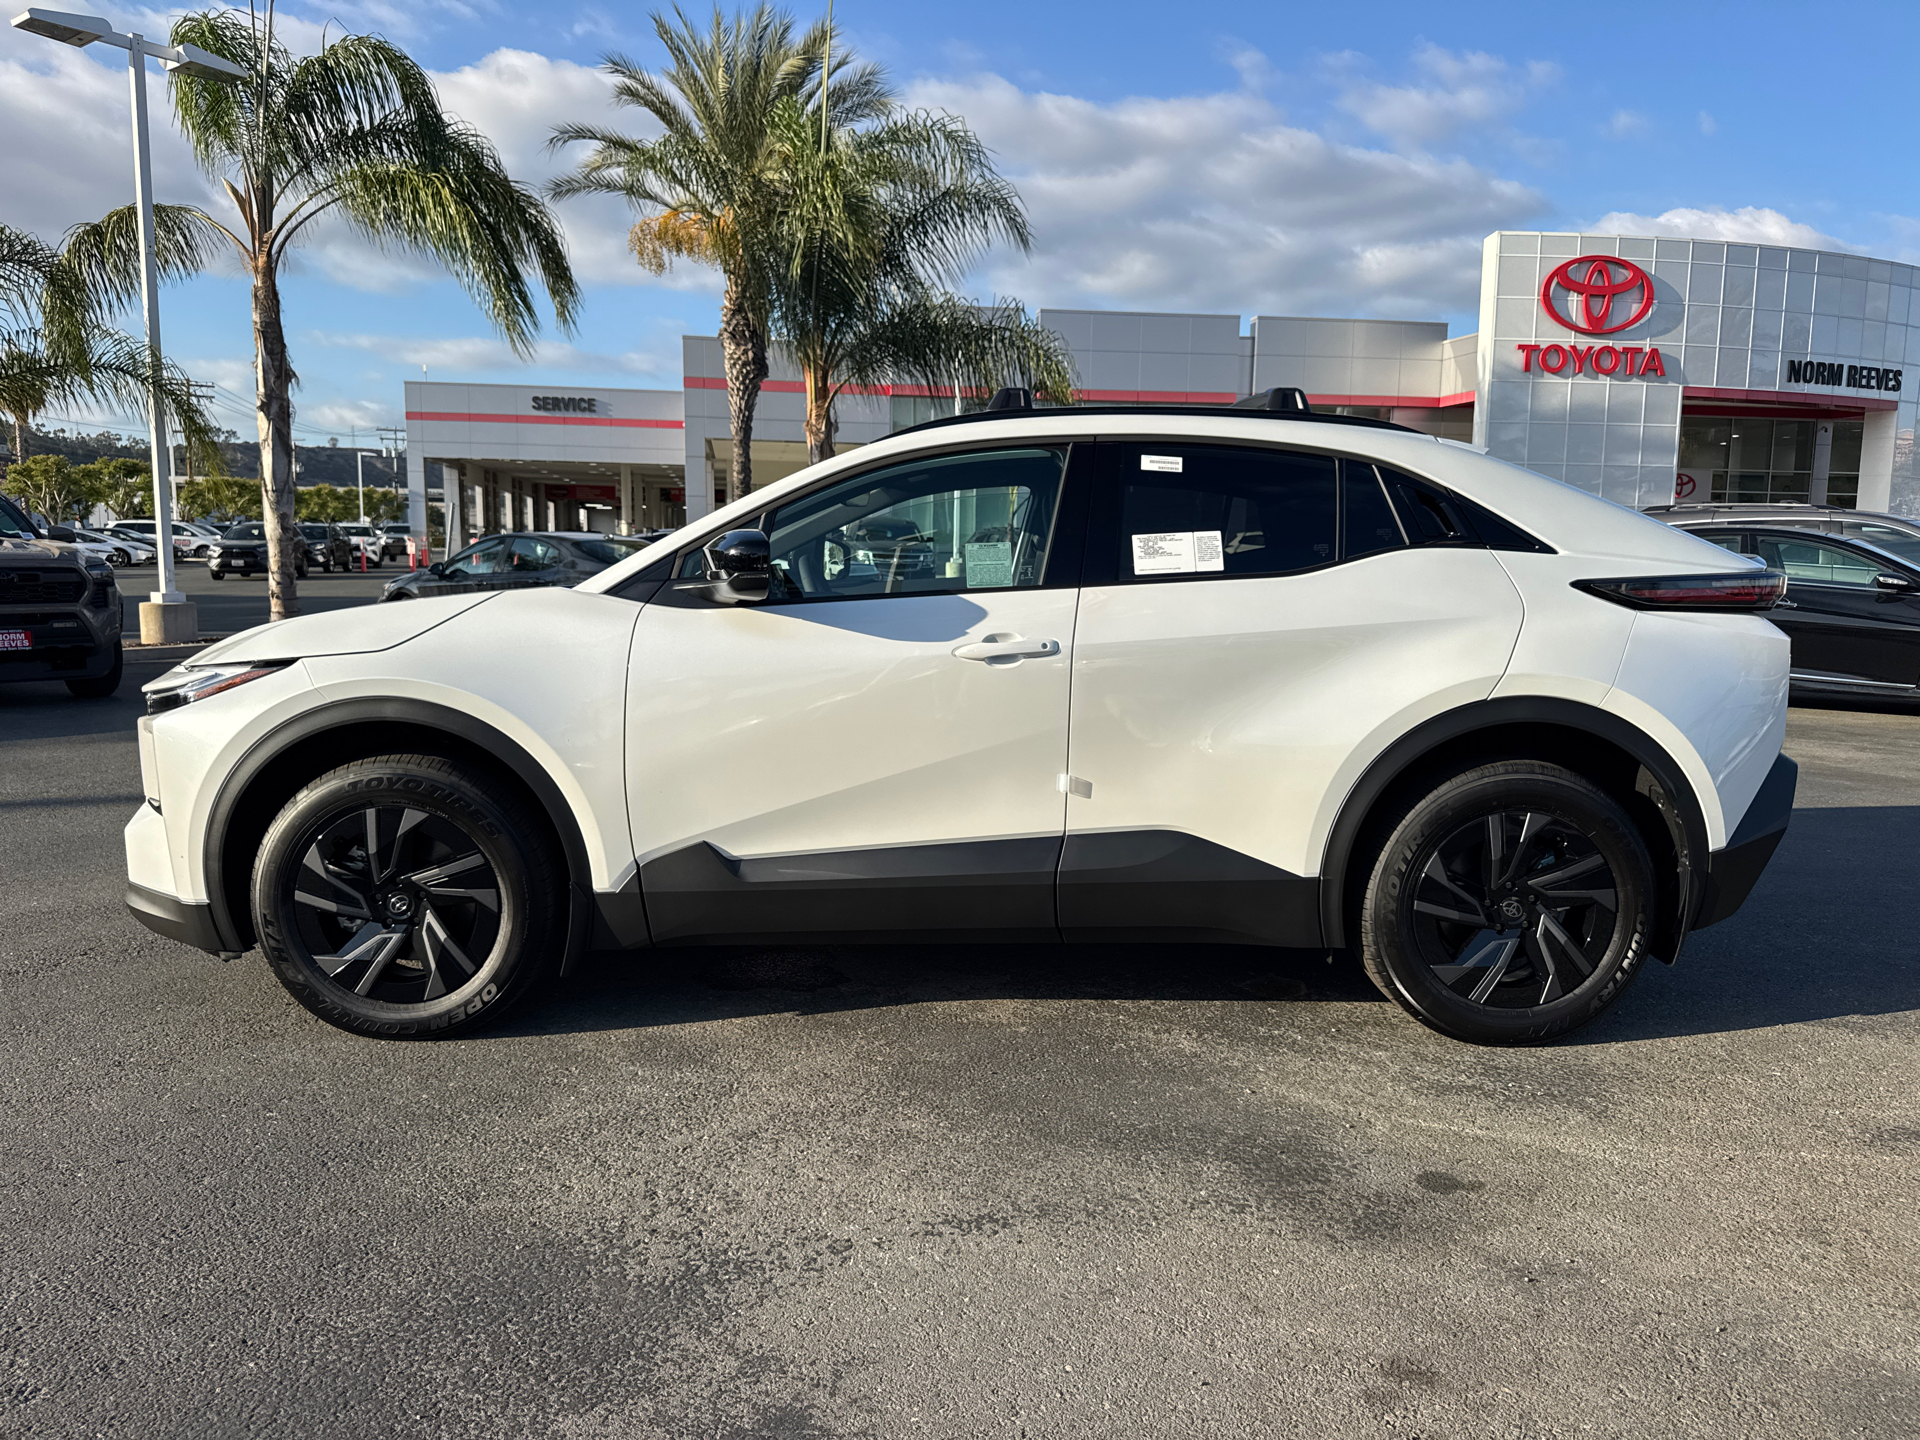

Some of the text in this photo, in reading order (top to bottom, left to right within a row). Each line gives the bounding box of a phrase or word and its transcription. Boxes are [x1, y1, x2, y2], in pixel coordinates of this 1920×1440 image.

[1516, 344, 1666, 376] TOYOTA
[1787, 360, 1902, 392] NORM REEVES
[532, 396, 597, 413] SERVICE
[344, 777, 426, 793] TOYO
[427, 784, 503, 839] TIRES
[1392, 802, 1452, 873] TIRES
[1588, 895, 1648, 1014] COUNTRY
[430, 982, 498, 1030] OPEN
